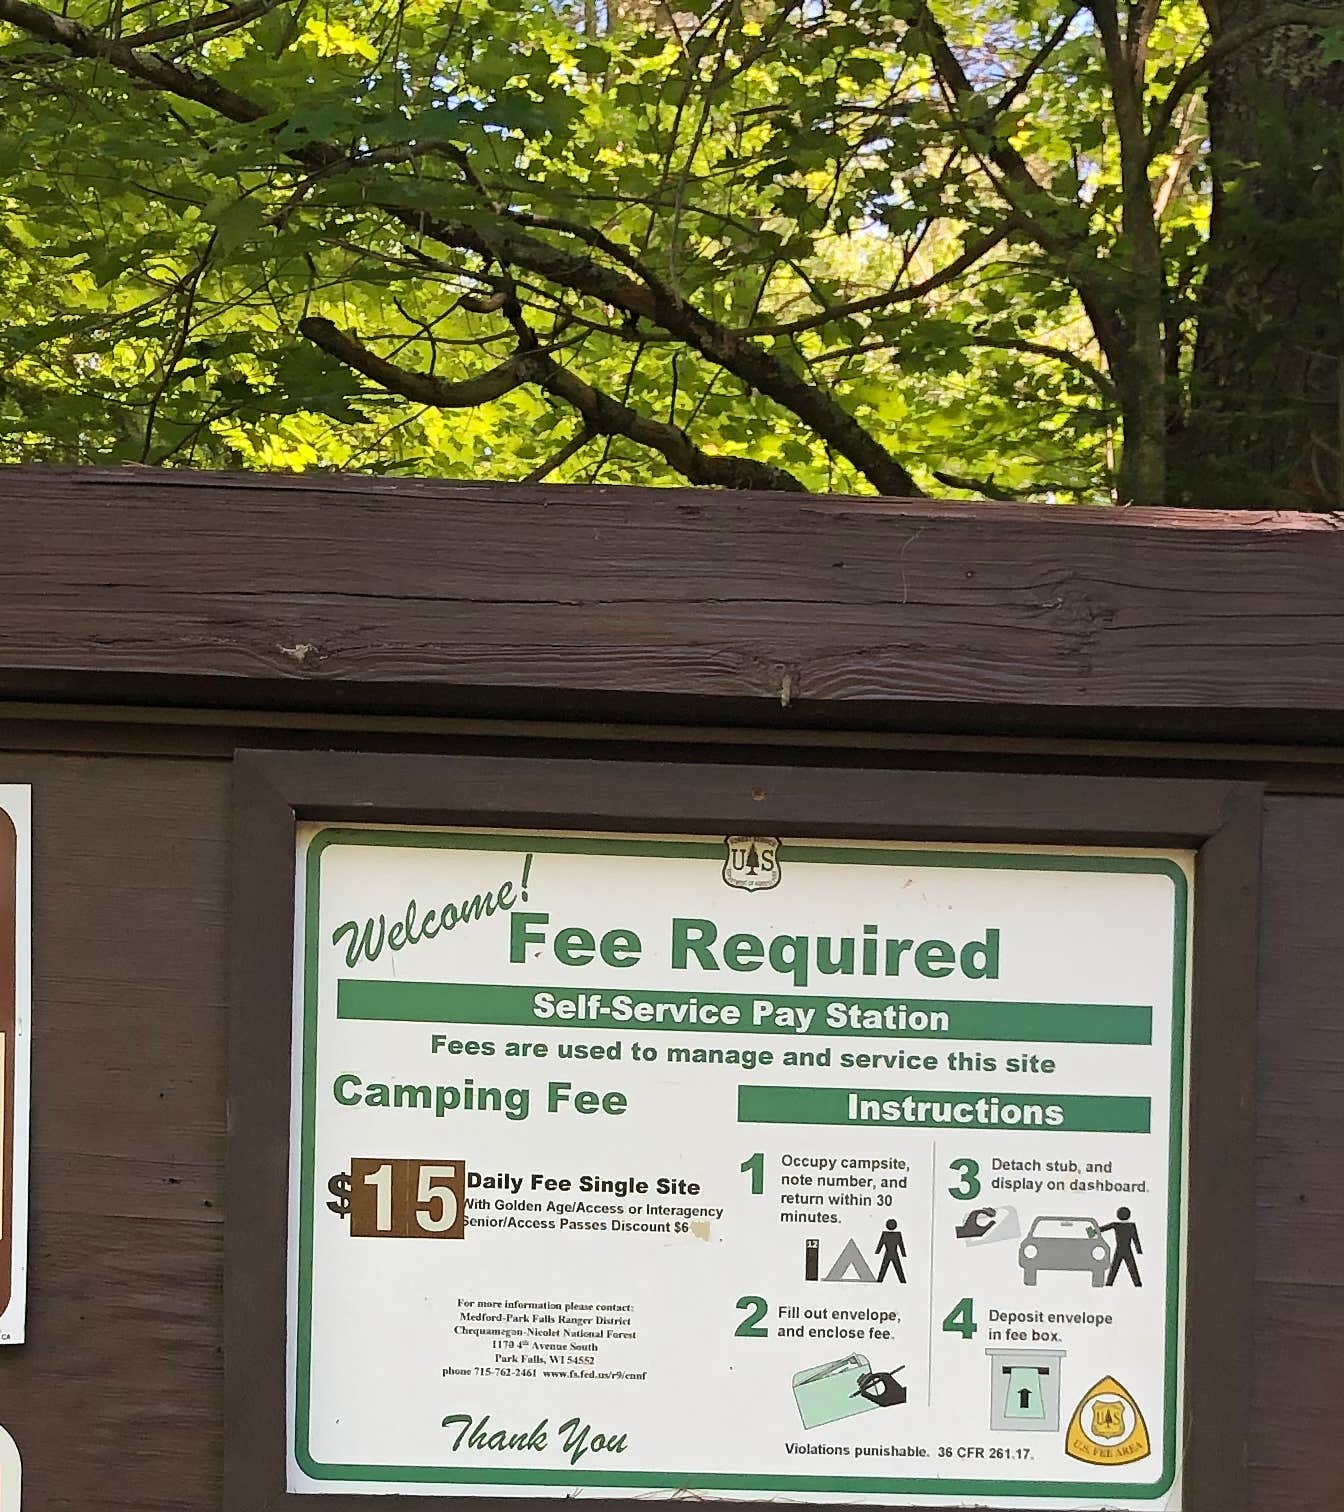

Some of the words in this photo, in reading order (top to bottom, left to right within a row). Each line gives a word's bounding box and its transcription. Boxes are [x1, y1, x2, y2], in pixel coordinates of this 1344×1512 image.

[332, 853, 534, 969] Welcome!
[510, 912, 642, 968] Fee
[671, 918, 1000, 987] Required
[533, 993, 740, 1024] Self-Service
[753, 1000, 815, 1033] Pay
[826, 1003, 949, 1031] Station
[432, 1034, 495, 1056] Fees
[505, 1042, 548, 1058] are
[558, 1041, 621, 1060] used
[631, 1042, 657, 1061] to
[667, 1048, 774, 1070] manage
[783, 1048, 831, 1067] and
[840, 1050, 938, 1070] service
[947, 1052, 997, 1072] this
[1006, 1054, 1056, 1073] site
[333, 1074, 529, 1121] Camping
[548, 1082, 627, 1115] Fee
[847, 1093, 1064, 1125] Instructions
[782, 1154, 837, 1171] Occupy
[841, 1157, 909, 1172] campsite,
[992, 1158, 1041, 1171] Detach
[1046, 1160, 1081, 1174] stub,
[1086, 1161, 1112, 1173] and
[740, 1153, 764, 1195] 1
[781, 1174, 813, 1186] note
[817, 1175, 876, 1190] number,
[881, 1176, 907, 1188] and
[948, 1158, 981, 1200] 3
[467, 1172, 523, 1194] Daily
[531, 1174, 571, 1191] Fee
[579, 1176, 649, 1197] Single
[656, 1178, 700, 1195] Site
[991, 1177, 1043, 1193] display
[1047, 1181, 1065, 1190] on
[1069, 1179, 1150, 1192] dashboard.
[495, 1199, 542, 1212] Golden
[546, 1200, 624, 1217] Age/Access
[628, 1204, 643, 1216] or
[646, 1204, 723, 1220] Interagency
[781, 1193, 823, 1205] return
[828, 1193, 872, 1206] within
[877, 1194, 892, 1207] 30
[560, 1218, 607, 1230] Passes
[612, 1220, 670, 1232] Discount
[781, 1212, 841, 1223] minutes.
[734, 1296, 768, 1338] 2
[779, 1306, 799, 1318] Fill
[804, 1308, 828, 1319] out
[832, 1308, 901, 1324] envelope,
[942, 1298, 978, 1340] 4
[989, 1309, 1044, 1325] Deposit
[1048, 1312, 1113, 1327] envelope
[778, 1325, 804, 1337] and
[809, 1326, 865, 1339] enclose
[869, 1327, 894, 1339] fee.
[989, 1328, 1001, 1340] in
[1005, 1328, 1027, 1341] fee
[1032, 1329, 1062, 1342] box.
[442, 1366, 471, 1377] phone
[474, 1367, 536, 1377] 715-762-2461
[442, 1414, 548, 1452] Thank
[558, 1417, 628, 1466] You
[785, 1443, 850, 1455] Violations
[855, 1445, 930, 1458] punishable.
[938, 1447, 953, 1458] 36
[957, 1447, 984, 1458] CFR
[989, 1448, 1034, 1460] 261.17.
